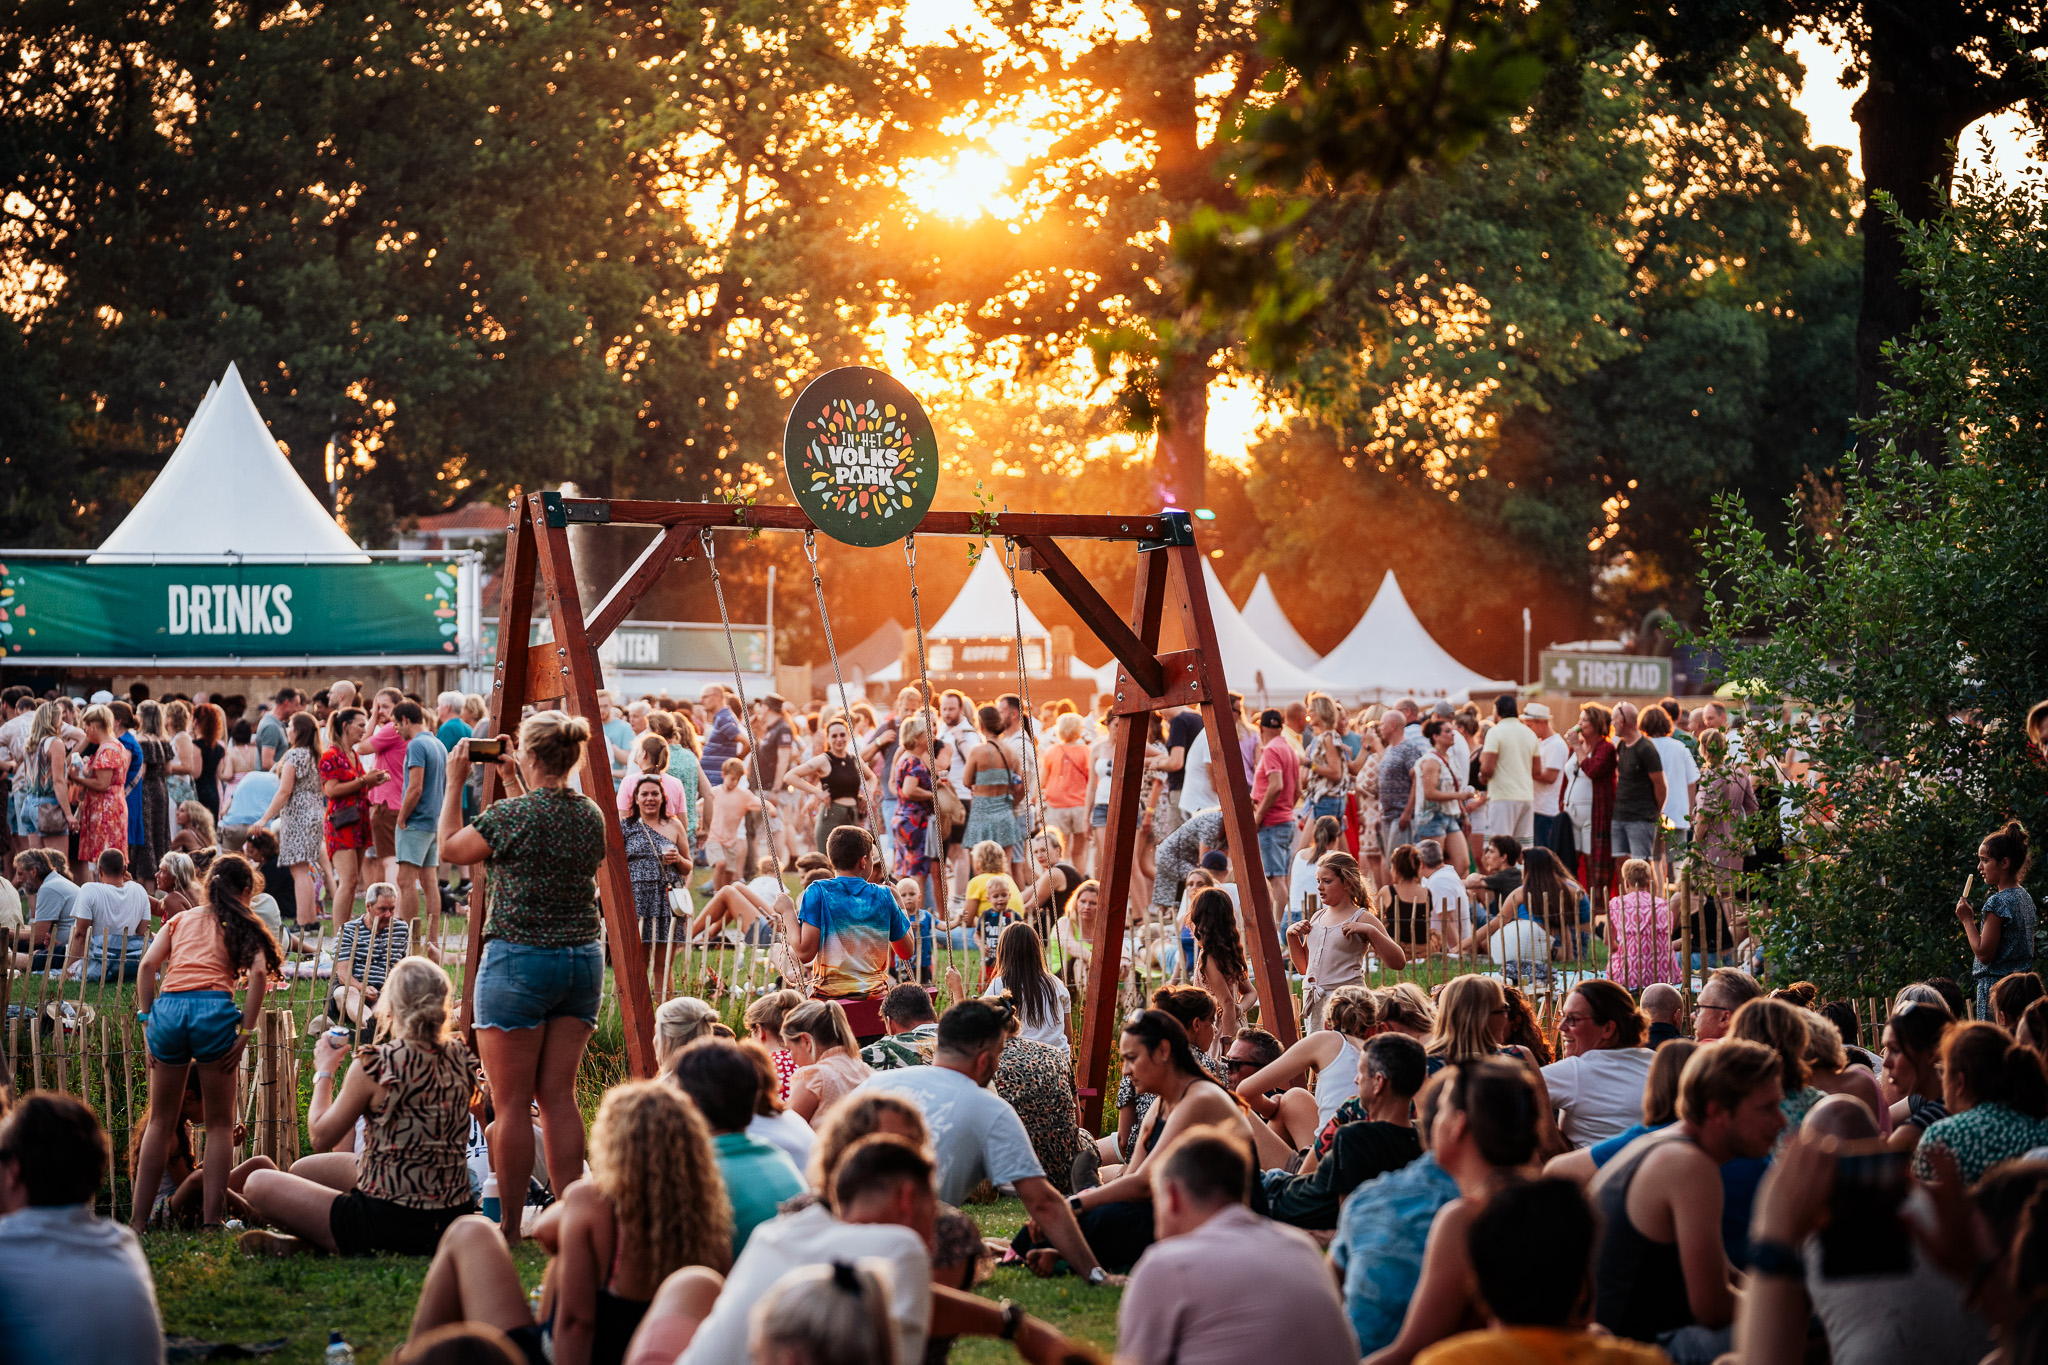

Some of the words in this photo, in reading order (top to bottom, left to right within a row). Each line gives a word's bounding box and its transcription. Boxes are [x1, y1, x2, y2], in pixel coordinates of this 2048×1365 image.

[841, 431, 855, 448] IN
[861, 433, 883, 448] HET
[827, 445, 900, 468] VOLKS
[835, 466, 895, 487] PARK
[168, 583, 293, 636] DRINKS
[606, 632, 660, 664] NTEN
[1577, 660, 1628, 688] FIRST
[1629, 663, 1661, 691] AID
